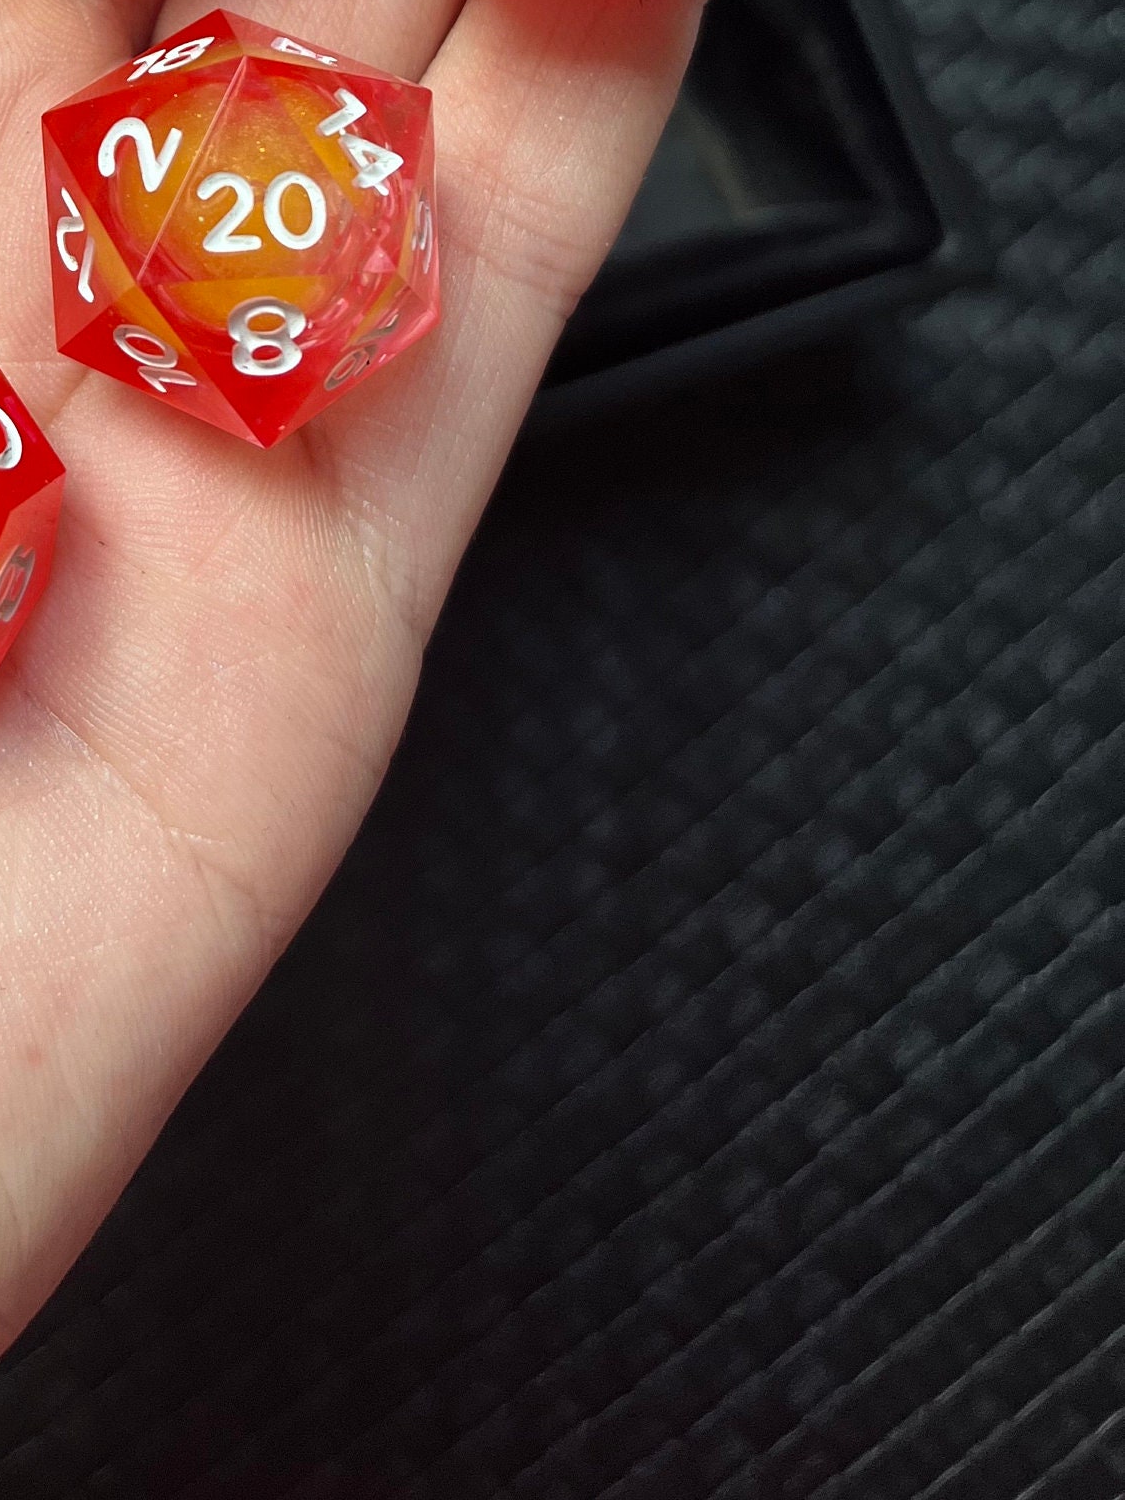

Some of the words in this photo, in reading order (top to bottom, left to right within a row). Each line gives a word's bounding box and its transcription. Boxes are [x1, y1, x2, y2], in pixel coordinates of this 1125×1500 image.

[127, 36, 215, 82] 18
[98, 116, 184, 193] 2
[316, 88, 405, 196] 14
[56, 187, 96, 304] 12
[197, 170, 328, 254] 20
[112, 324, 198, 394] 10
[227, 296, 308, 377] 8
